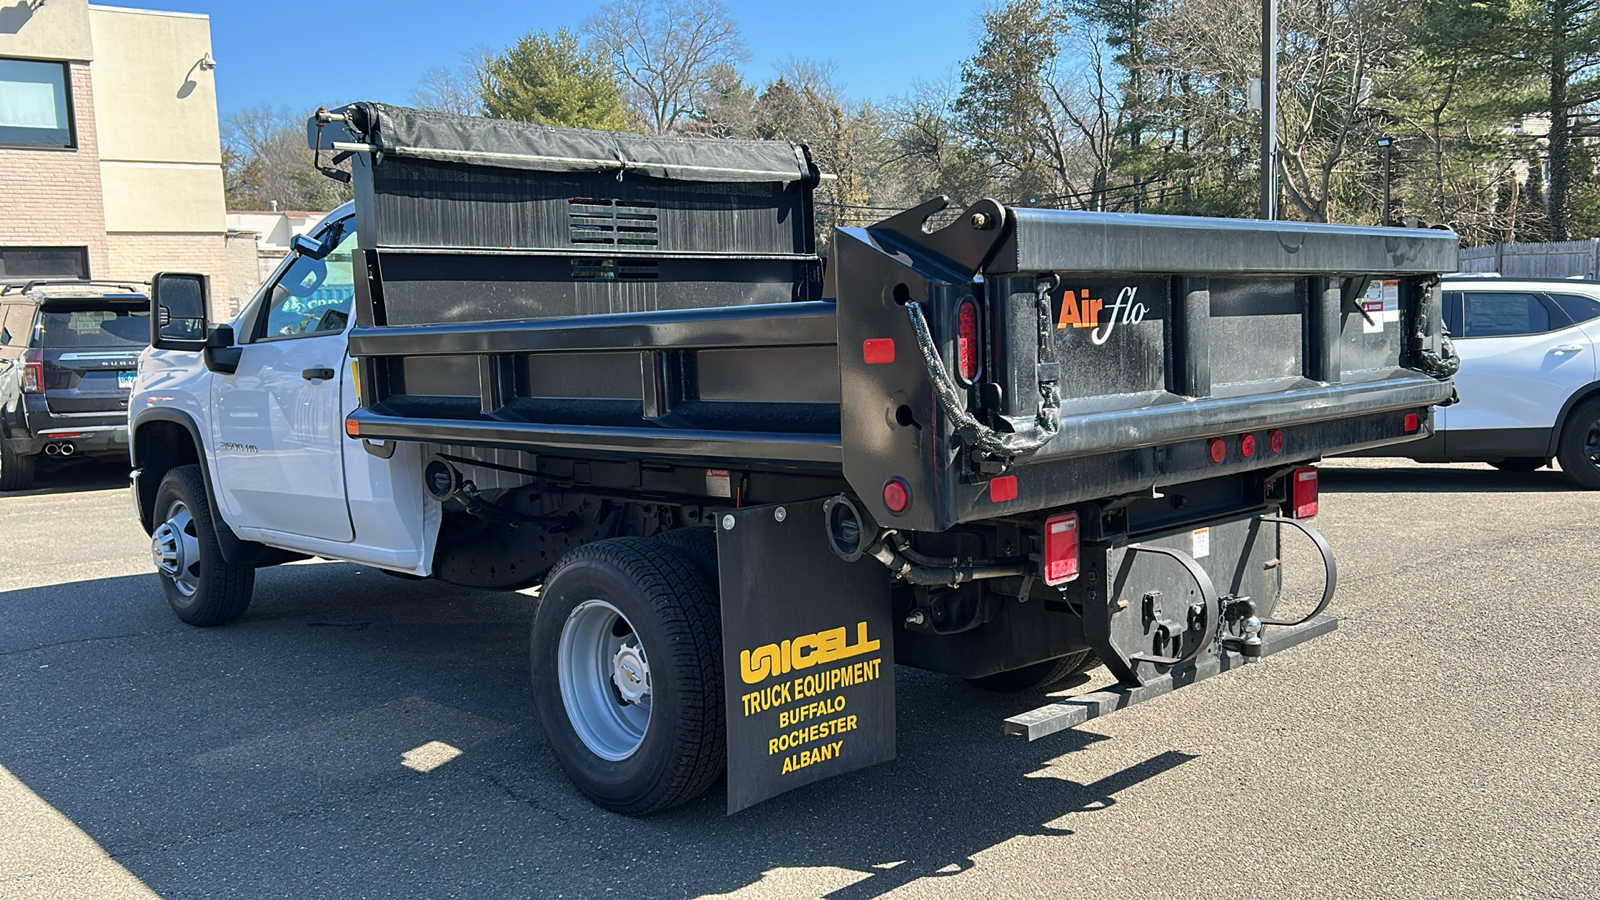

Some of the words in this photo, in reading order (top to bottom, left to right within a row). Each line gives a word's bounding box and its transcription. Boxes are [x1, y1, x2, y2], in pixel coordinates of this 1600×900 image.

[740, 621, 881, 684] UNICELL
[741, 681, 791, 717] TRUCK
[794, 658, 882, 700] EQUIPMENT
[779, 695, 846, 728] BUFFALO
[769, 714, 858, 755] ROCHESTER
[781, 740, 844, 775] ALBANY
